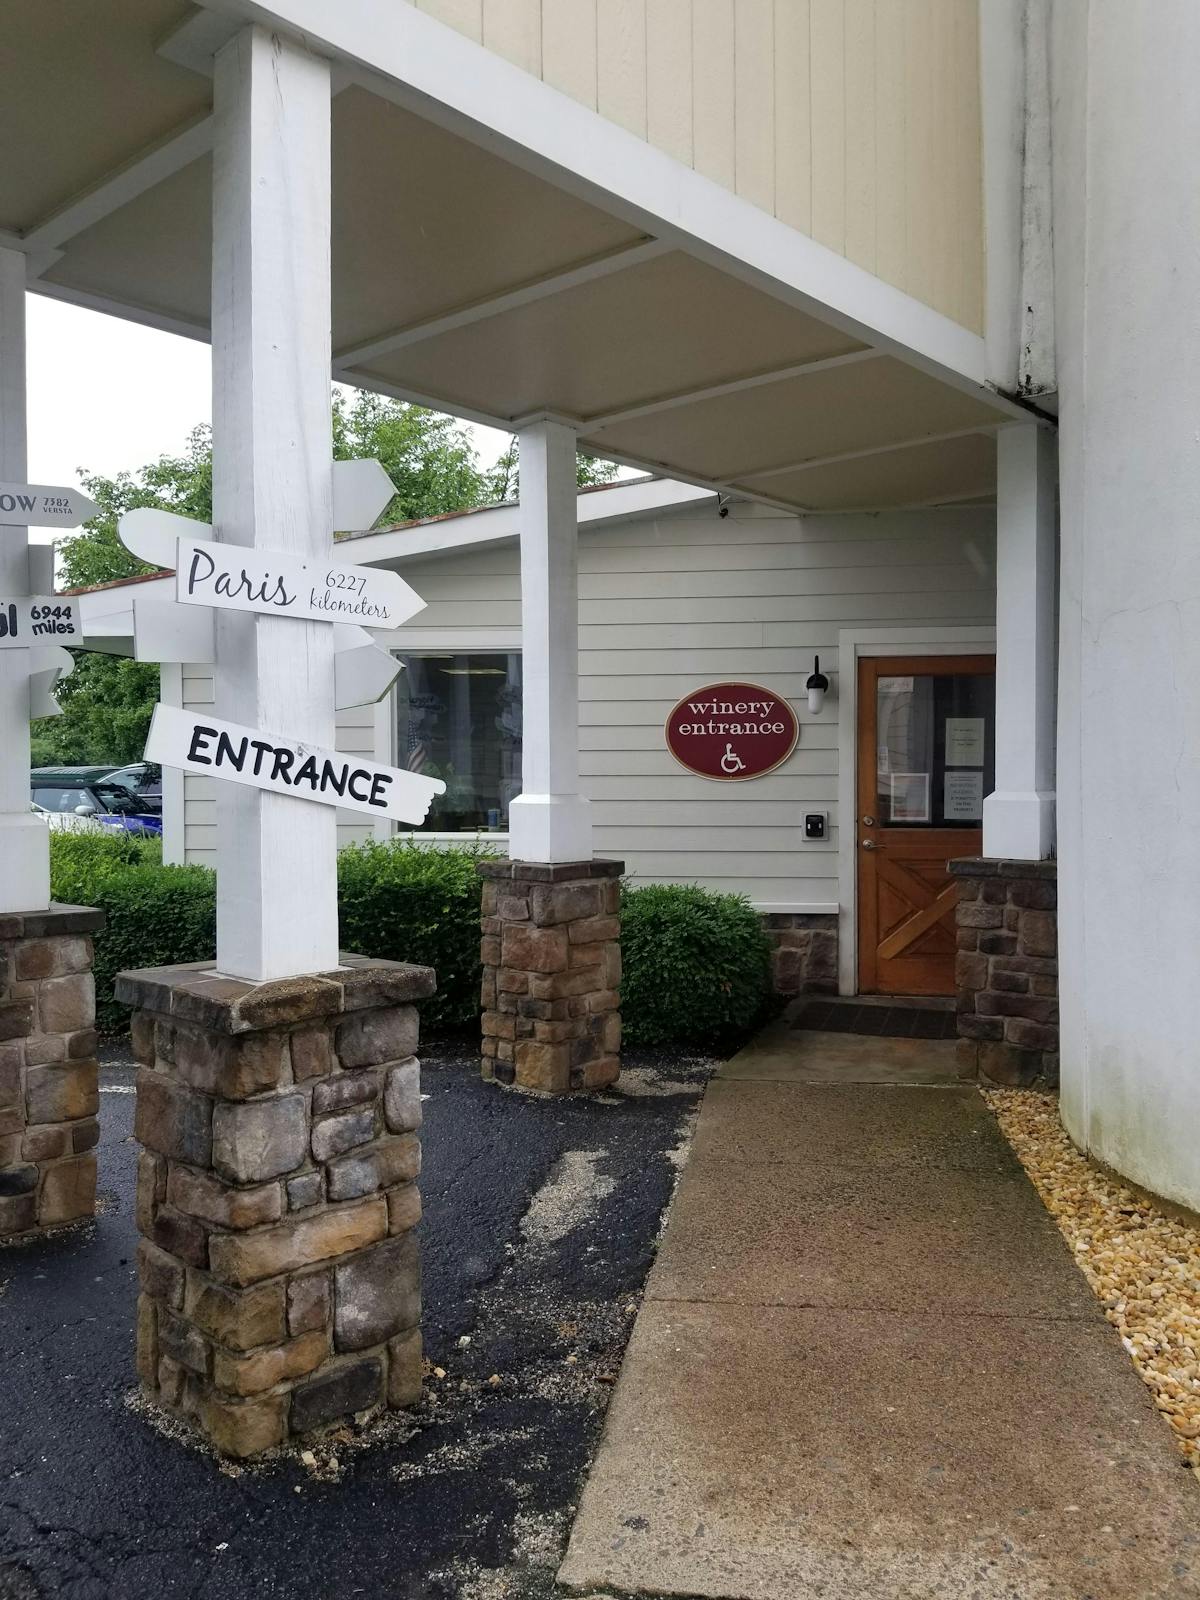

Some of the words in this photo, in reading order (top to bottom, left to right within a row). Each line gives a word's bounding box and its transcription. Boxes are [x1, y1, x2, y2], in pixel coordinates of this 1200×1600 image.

[188, 548, 297, 607] Paris
[325, 569, 367, 596] 6227
[30, 605, 72, 620] 6944
[309, 587, 392, 619] kilometers
[32, 619, 75, 636] miles
[688, 698, 775, 718] winery
[679, 719, 785, 735] entrance
[187, 725, 393, 808] ENTRANCE
